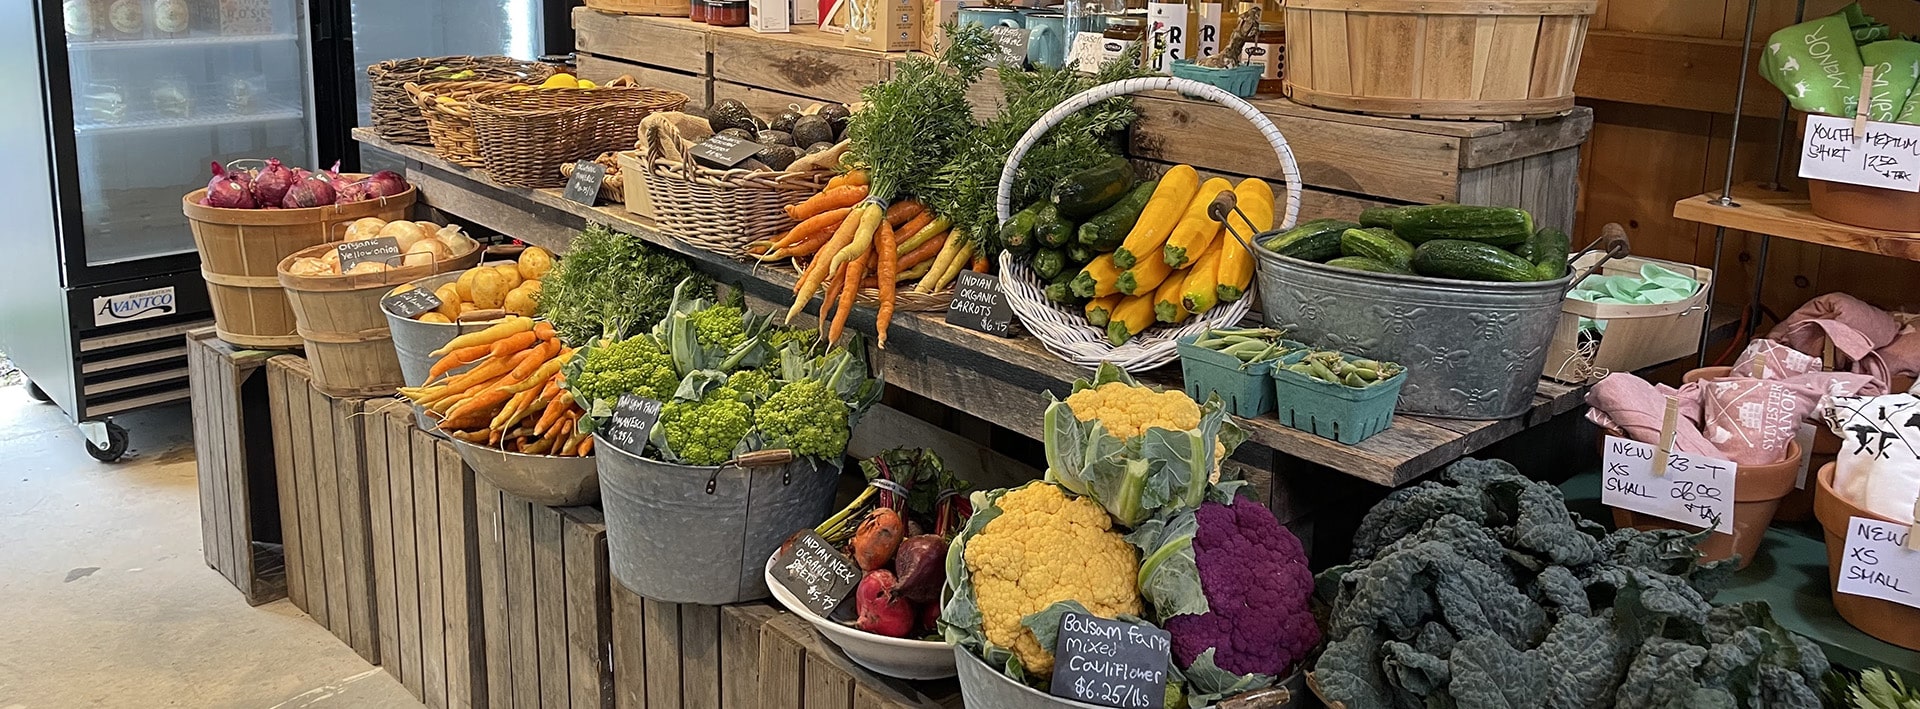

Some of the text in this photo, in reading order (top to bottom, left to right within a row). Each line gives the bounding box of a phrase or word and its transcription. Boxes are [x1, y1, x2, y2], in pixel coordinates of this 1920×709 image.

[1811, 123, 1855, 145] YOUTH
[1807, 144, 1851, 162] SHIRT
[338, 240, 379, 251] Organic
[961, 274, 992, 290] INDIAN
[97, 294, 173, 317] AVANTCO
[950, 298, 992, 316] CARROTS
[960, 288, 997, 305] ORGANIC
[1763, 383, 1784, 451] SYLVESTER
[1613, 442, 1652, 460] NEW
[1608, 462, 1630, 476] XS
[1605, 477, 1657, 498] SMALL
[1857, 523, 1909, 547] NEW
[795, 548, 832, 582] ORGANIC
[802, 534, 856, 585] INDIAN NECK
[1850, 547, 1879, 566] XS
[1847, 565, 1912, 594] SMALL
[807, 585, 837, 610] $5.75
[1064, 613, 1122, 641] Balsam
